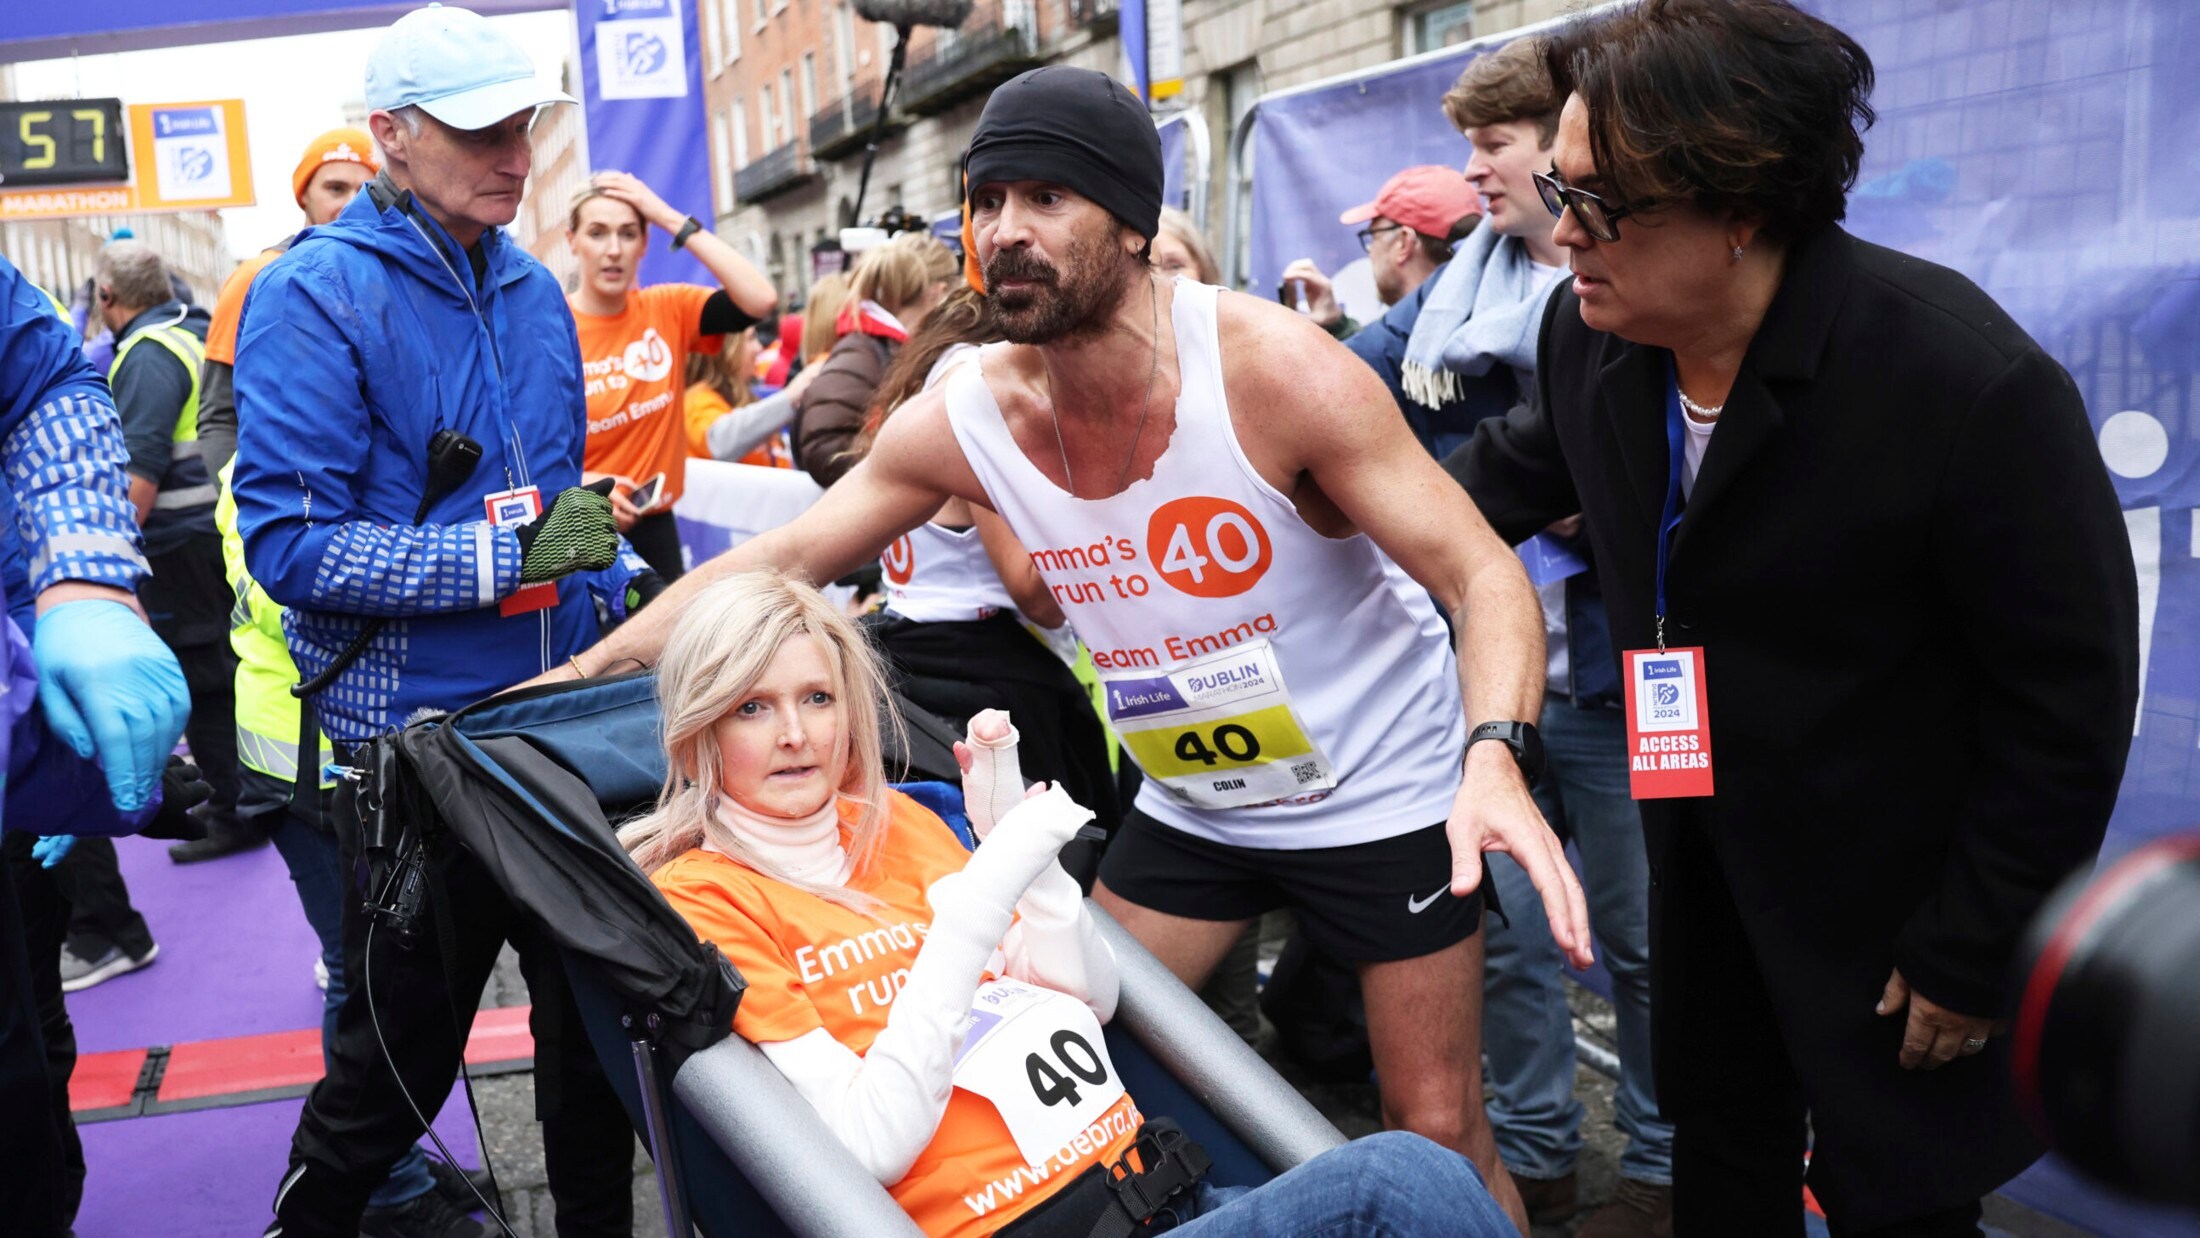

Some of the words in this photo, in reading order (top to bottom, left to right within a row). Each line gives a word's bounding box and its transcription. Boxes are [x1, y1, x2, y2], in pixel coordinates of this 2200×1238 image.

[3, 190, 128, 213] MARATHON
[586, 411, 628, 434] eam
[1029, 535, 1137, 571] mma's
[1161, 512, 1259, 583] 40
[1052, 582, 1105, 605] run
[1109, 574, 1149, 599] to
[1087, 645, 1160, 669] eam
[1164, 613, 1276, 661] Emma
[1125, 694, 1149, 706] Irish
[1149, 691, 1171, 703] Life
[1654, 709, 1680, 718] 2024
[1175, 724, 1260, 765] 40
[1640, 735, 1699, 753] ACCESS
[1632, 755, 1657, 771] ALL
[1660, 752, 1709, 770] AREAS
[1213, 778, 1246, 792] COLIN
[1025, 1030, 1107, 1107] 40
